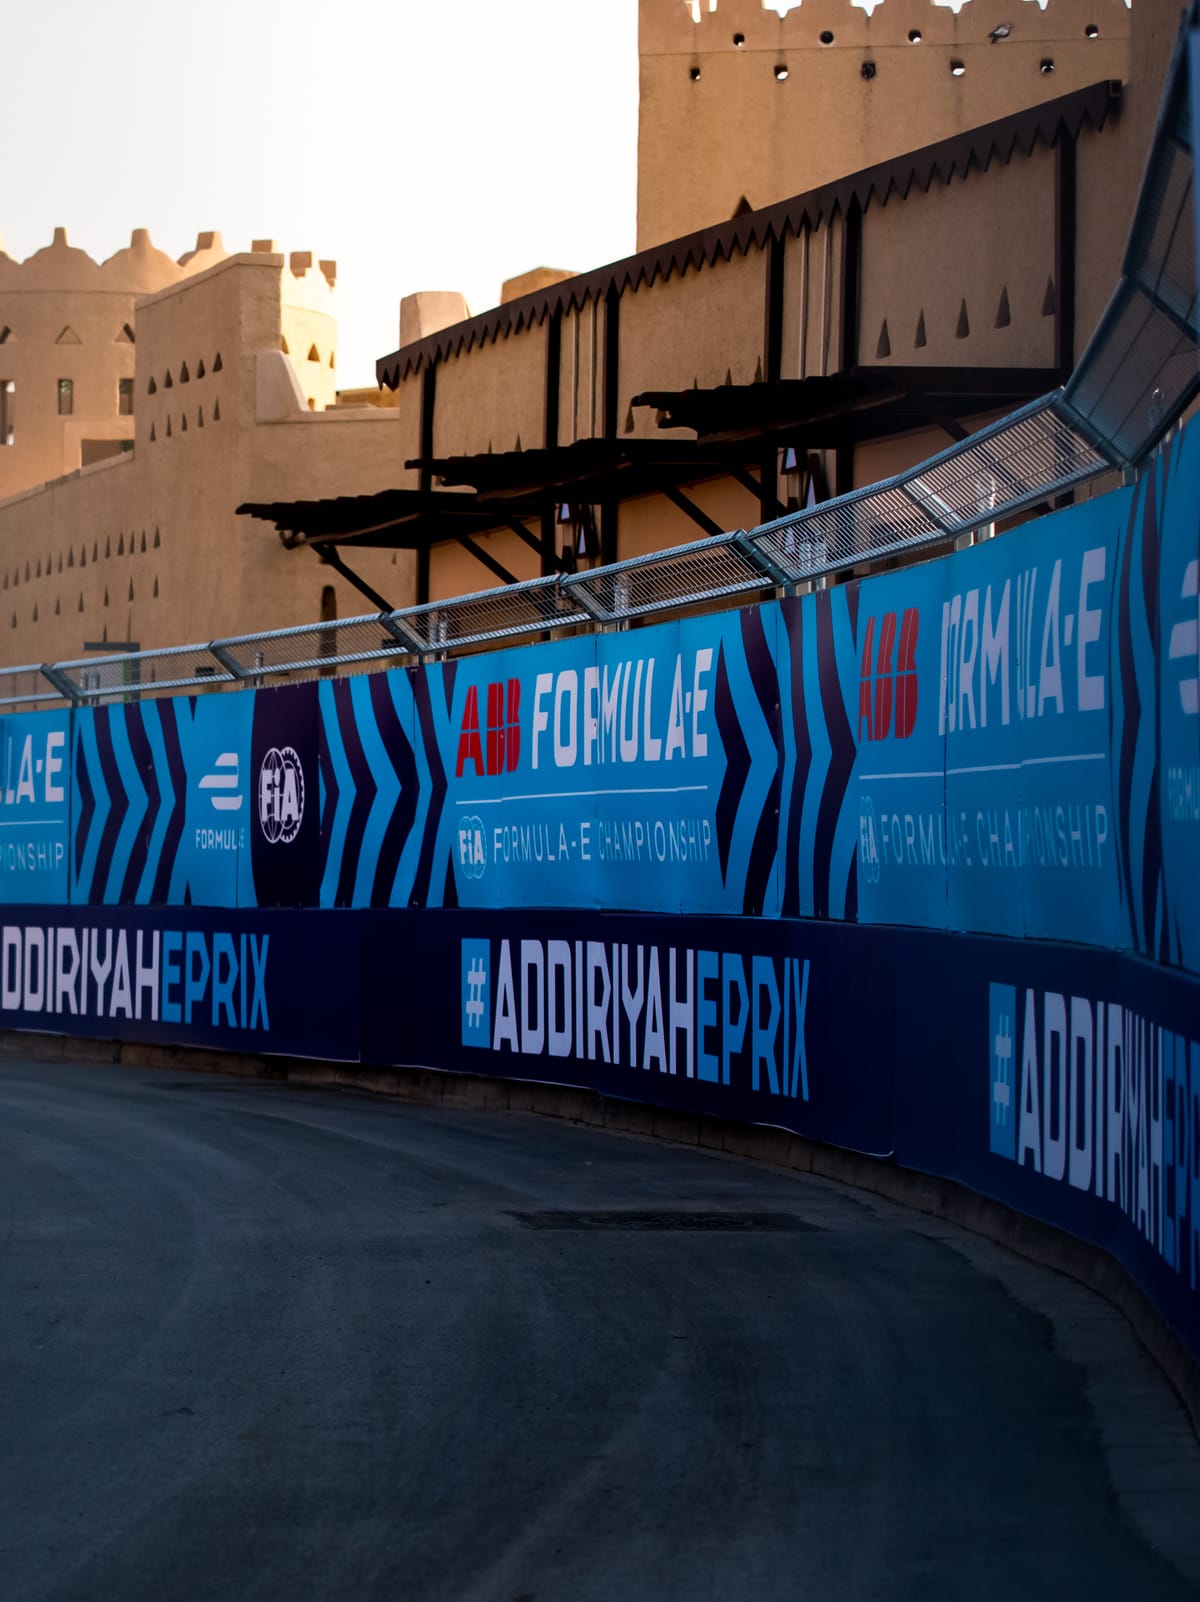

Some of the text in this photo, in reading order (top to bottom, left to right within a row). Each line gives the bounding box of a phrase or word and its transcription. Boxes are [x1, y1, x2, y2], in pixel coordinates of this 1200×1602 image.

[858, 608, 919, 743] ABB
[455, 677, 521, 778] ABB
[599, 818, 712, 862] CHAMPIONSHIP
